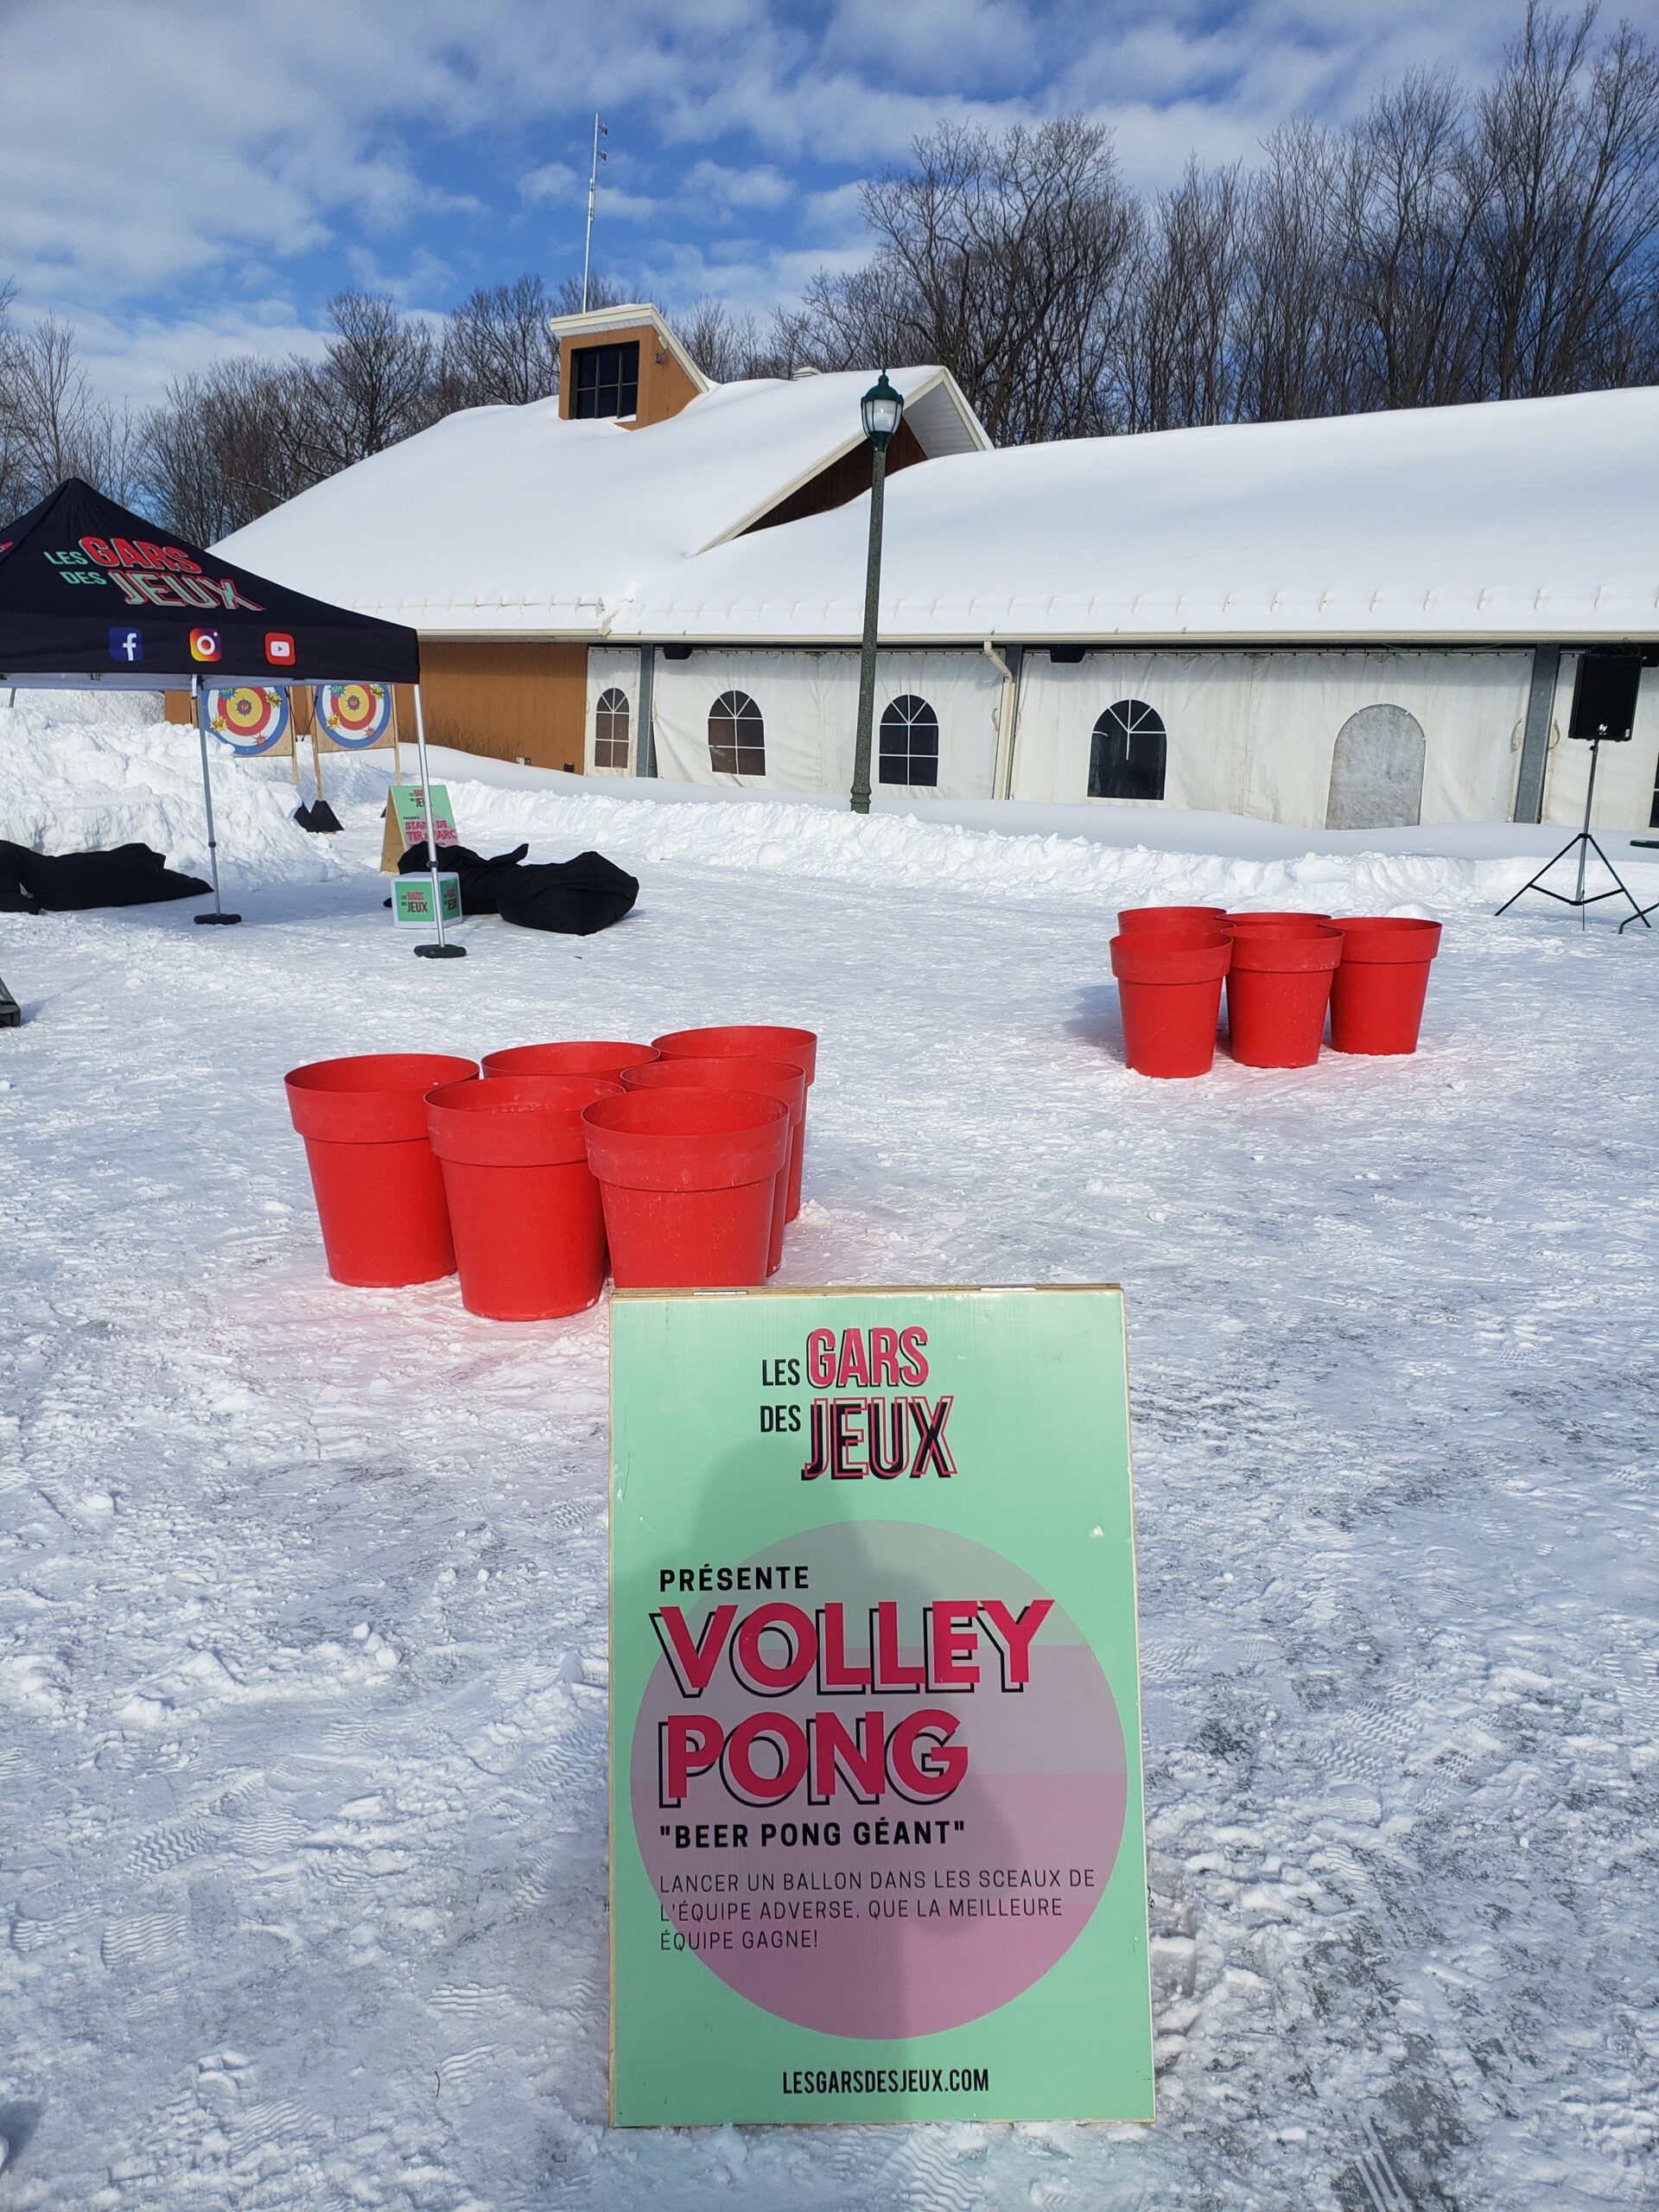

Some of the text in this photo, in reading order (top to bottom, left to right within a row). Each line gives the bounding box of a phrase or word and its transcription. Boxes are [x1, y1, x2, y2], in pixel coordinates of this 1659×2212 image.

[43, 536, 202, 575] LES GARS
[59, 569, 266, 612] DES JEUX
[405, 830, 423, 842] TIR
[407, 901, 429, 913] JEUX
[762, 1325, 930, 1389] LES GARS
[760, 1395, 958, 1481] DES JEUX
[659, 1563, 809, 1592] PRÉSENTE
[649, 1599, 1056, 1699] VOLLEY
[658, 1708, 969, 1808] PONG
[659, 1816, 965, 1849] "BEER PONG GÉANT"
[659, 1869, 1096, 1893] LANCER UN BALLON DANS LES SCEAUX DE
[659, 1897, 1064, 1923] L'ÉQUIPE ADVERSE. QUE LA MEILLEURE
[659, 1928, 818, 1951] ÉQUIPE GAGNE!
[782, 2068, 990, 2094] LESGARSDESJEUX.COM
